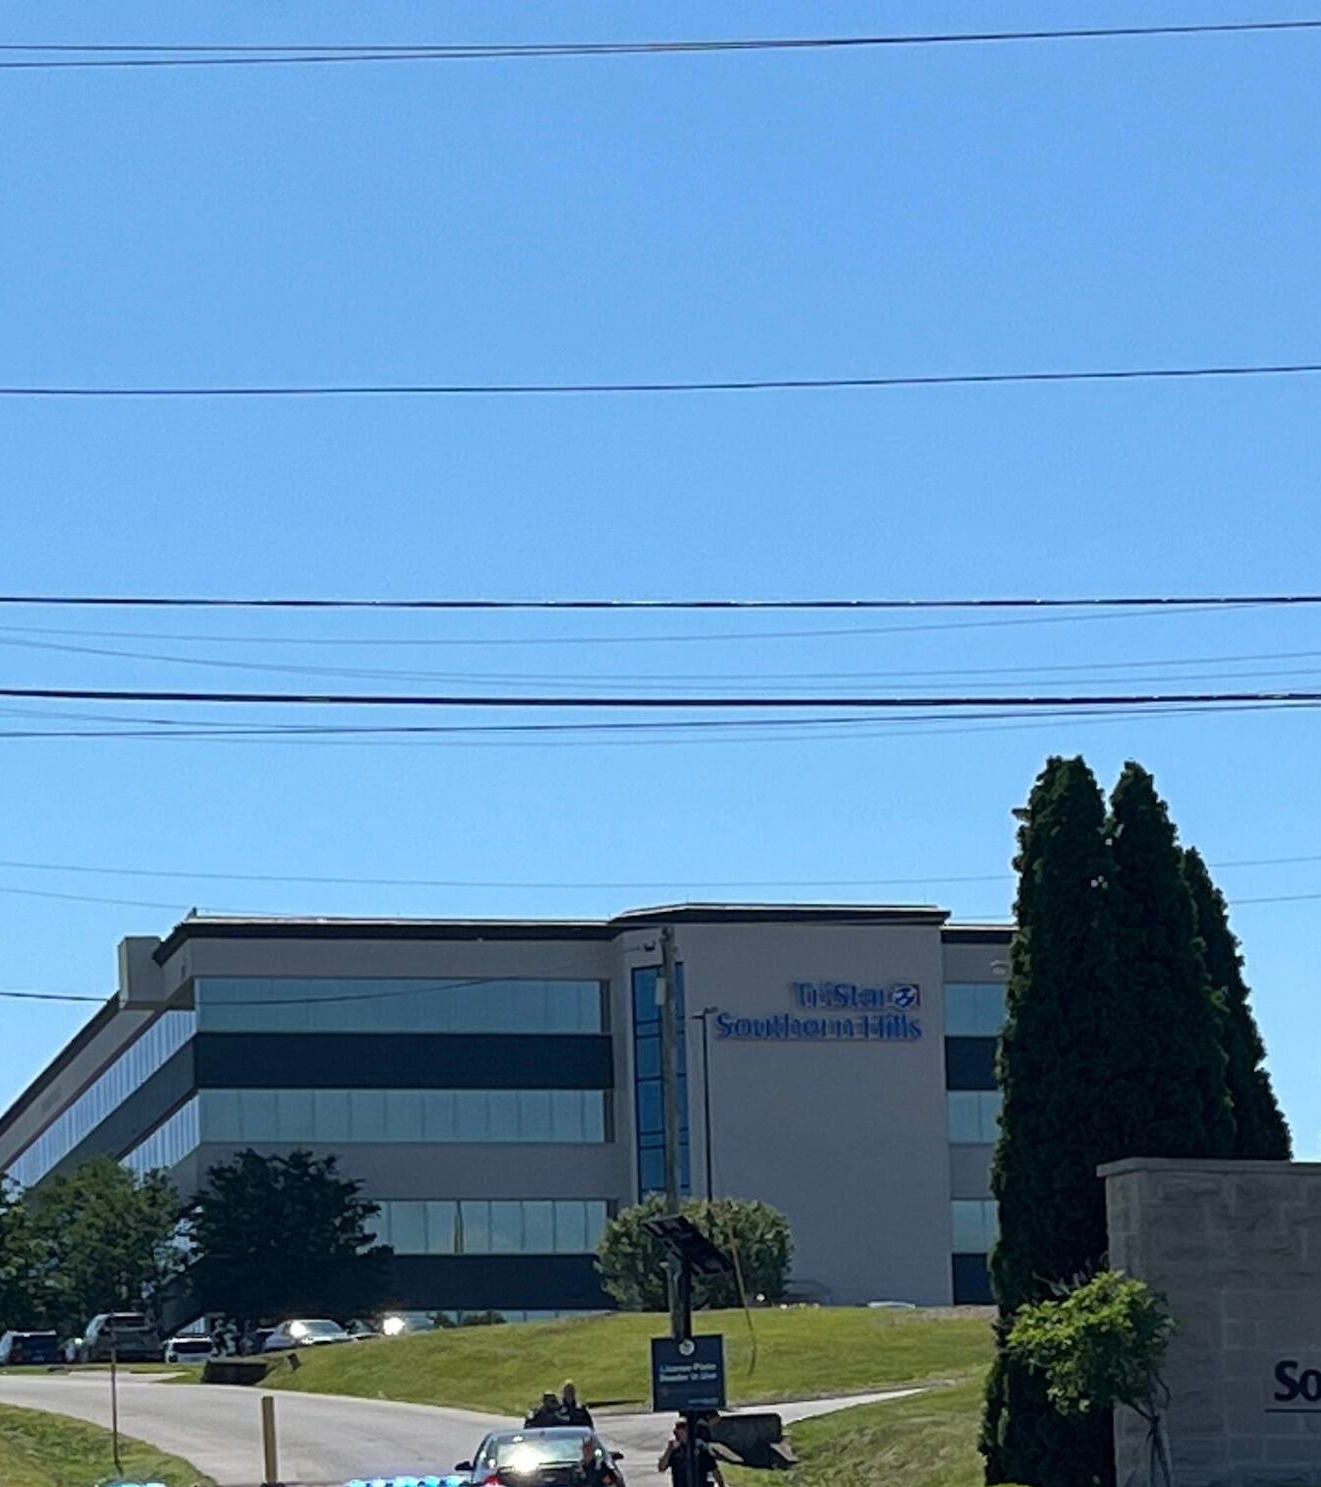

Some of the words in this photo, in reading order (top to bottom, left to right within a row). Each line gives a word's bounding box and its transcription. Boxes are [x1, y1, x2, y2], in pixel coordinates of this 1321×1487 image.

[791, 981, 885, 1008] TriStar
[716, 1012, 854, 1038] Southern
[861, 1013, 922, 1038] Hills
